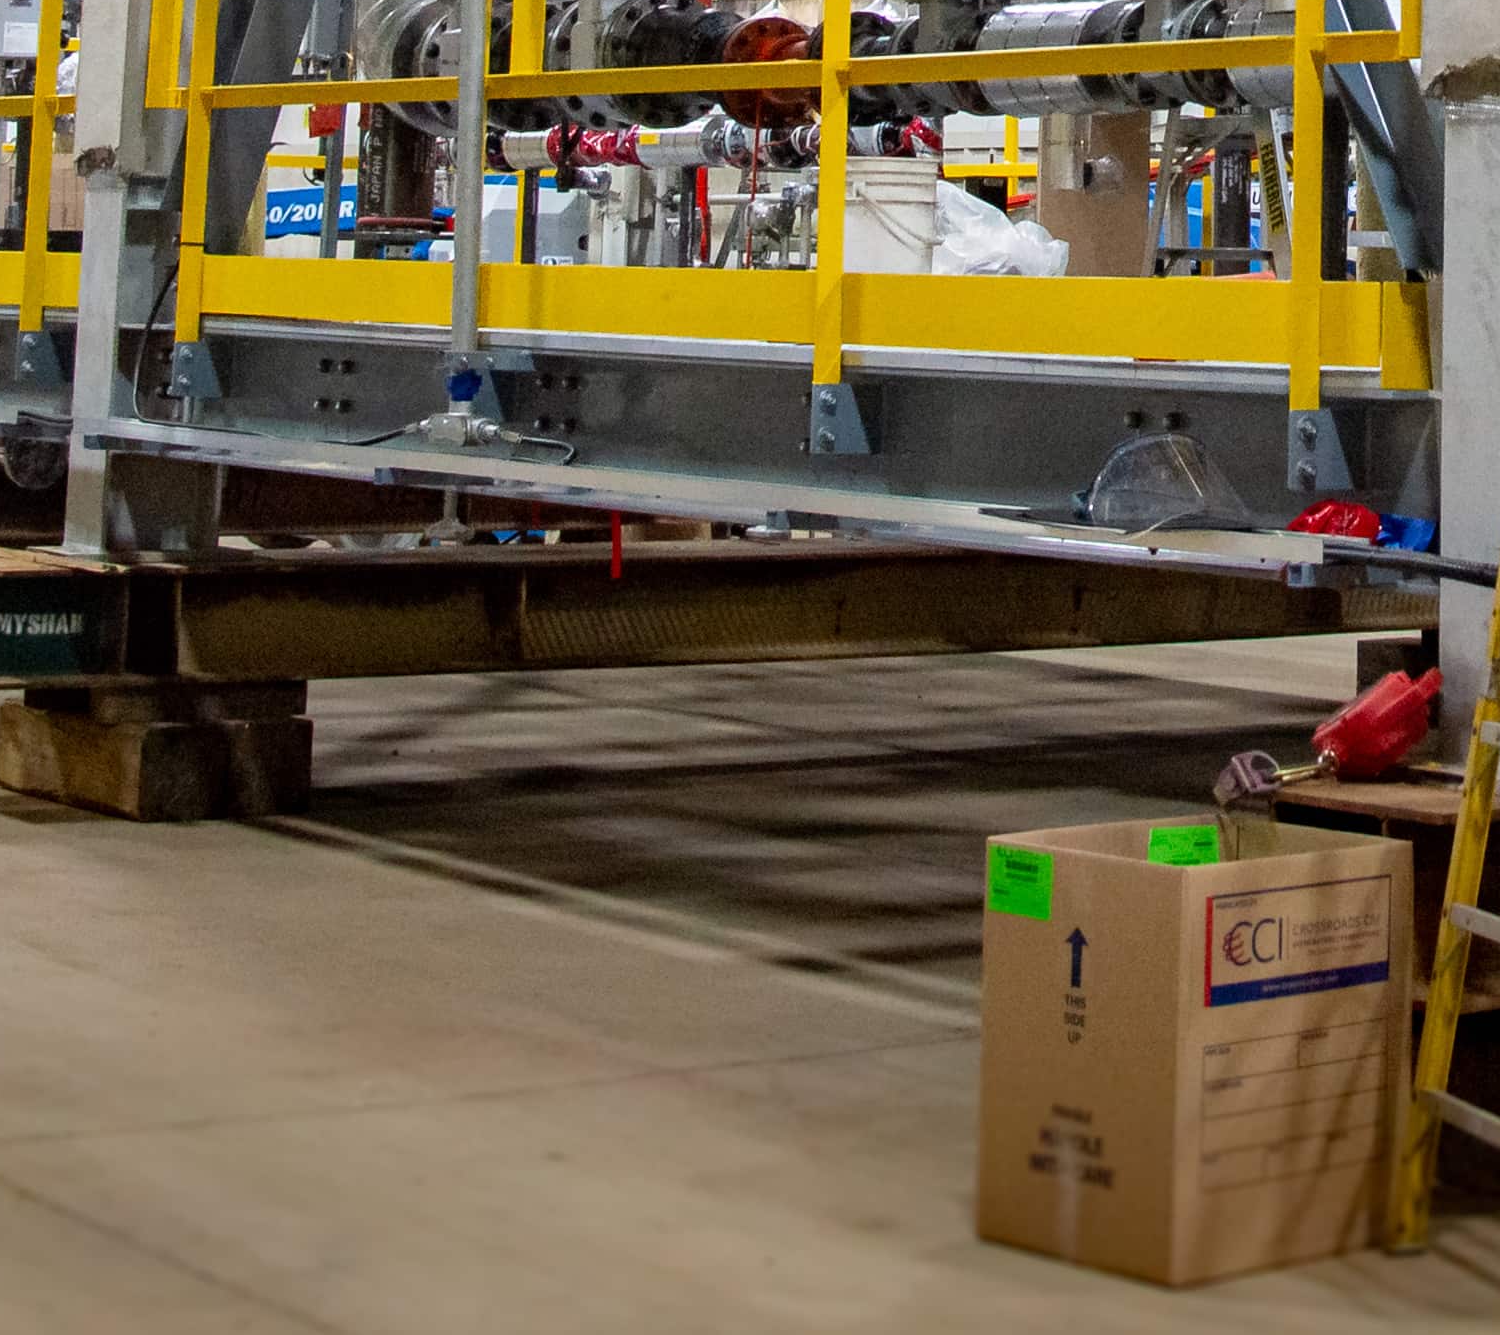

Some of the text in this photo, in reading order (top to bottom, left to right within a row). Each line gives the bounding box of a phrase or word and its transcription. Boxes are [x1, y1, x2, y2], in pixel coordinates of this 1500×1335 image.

[371, 155, 384, 204] JAPAN
[1065, 994, 1087, 1010] THIS
[1066, 1032, 1083, 1045] UP
